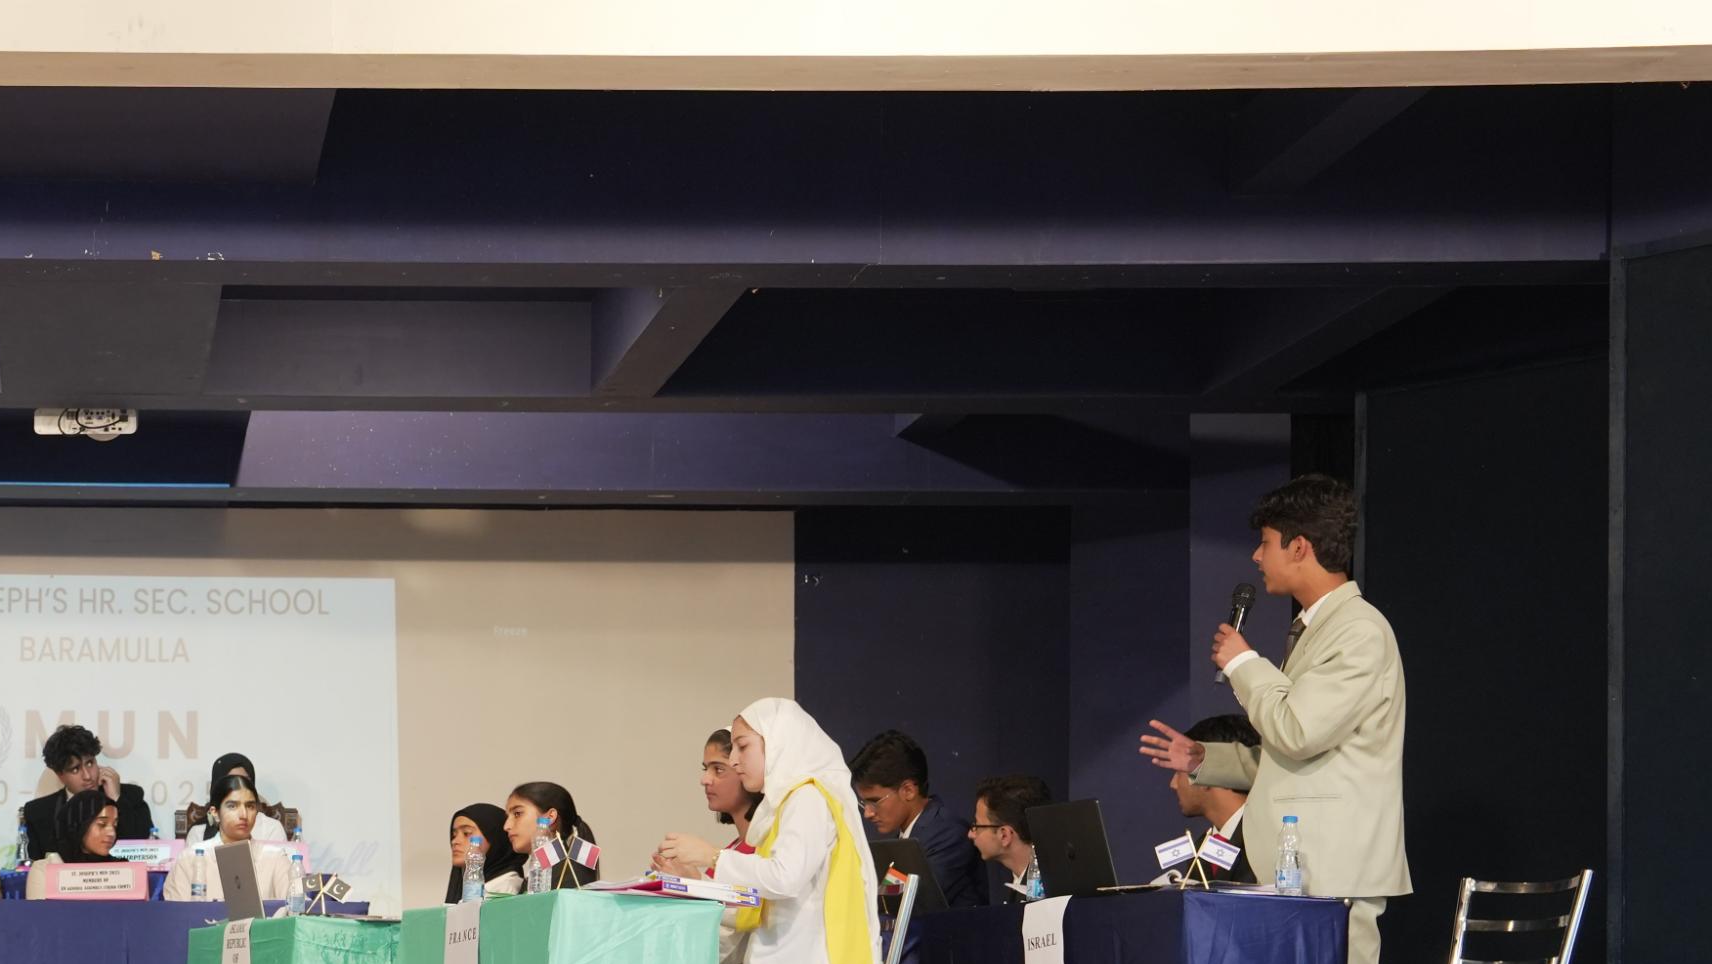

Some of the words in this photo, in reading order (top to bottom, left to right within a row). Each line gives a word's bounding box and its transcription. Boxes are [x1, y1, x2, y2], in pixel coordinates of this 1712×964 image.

[79, 588, 123, 615] HR.
[133, 588, 196, 616] SEC.
[207, 588, 330, 616] SCHOOL
[19, 636, 190, 663] BARAMULLA
[448, 927, 477, 945] FRANCE
[1027, 932, 1057, 951] ISRAEL
